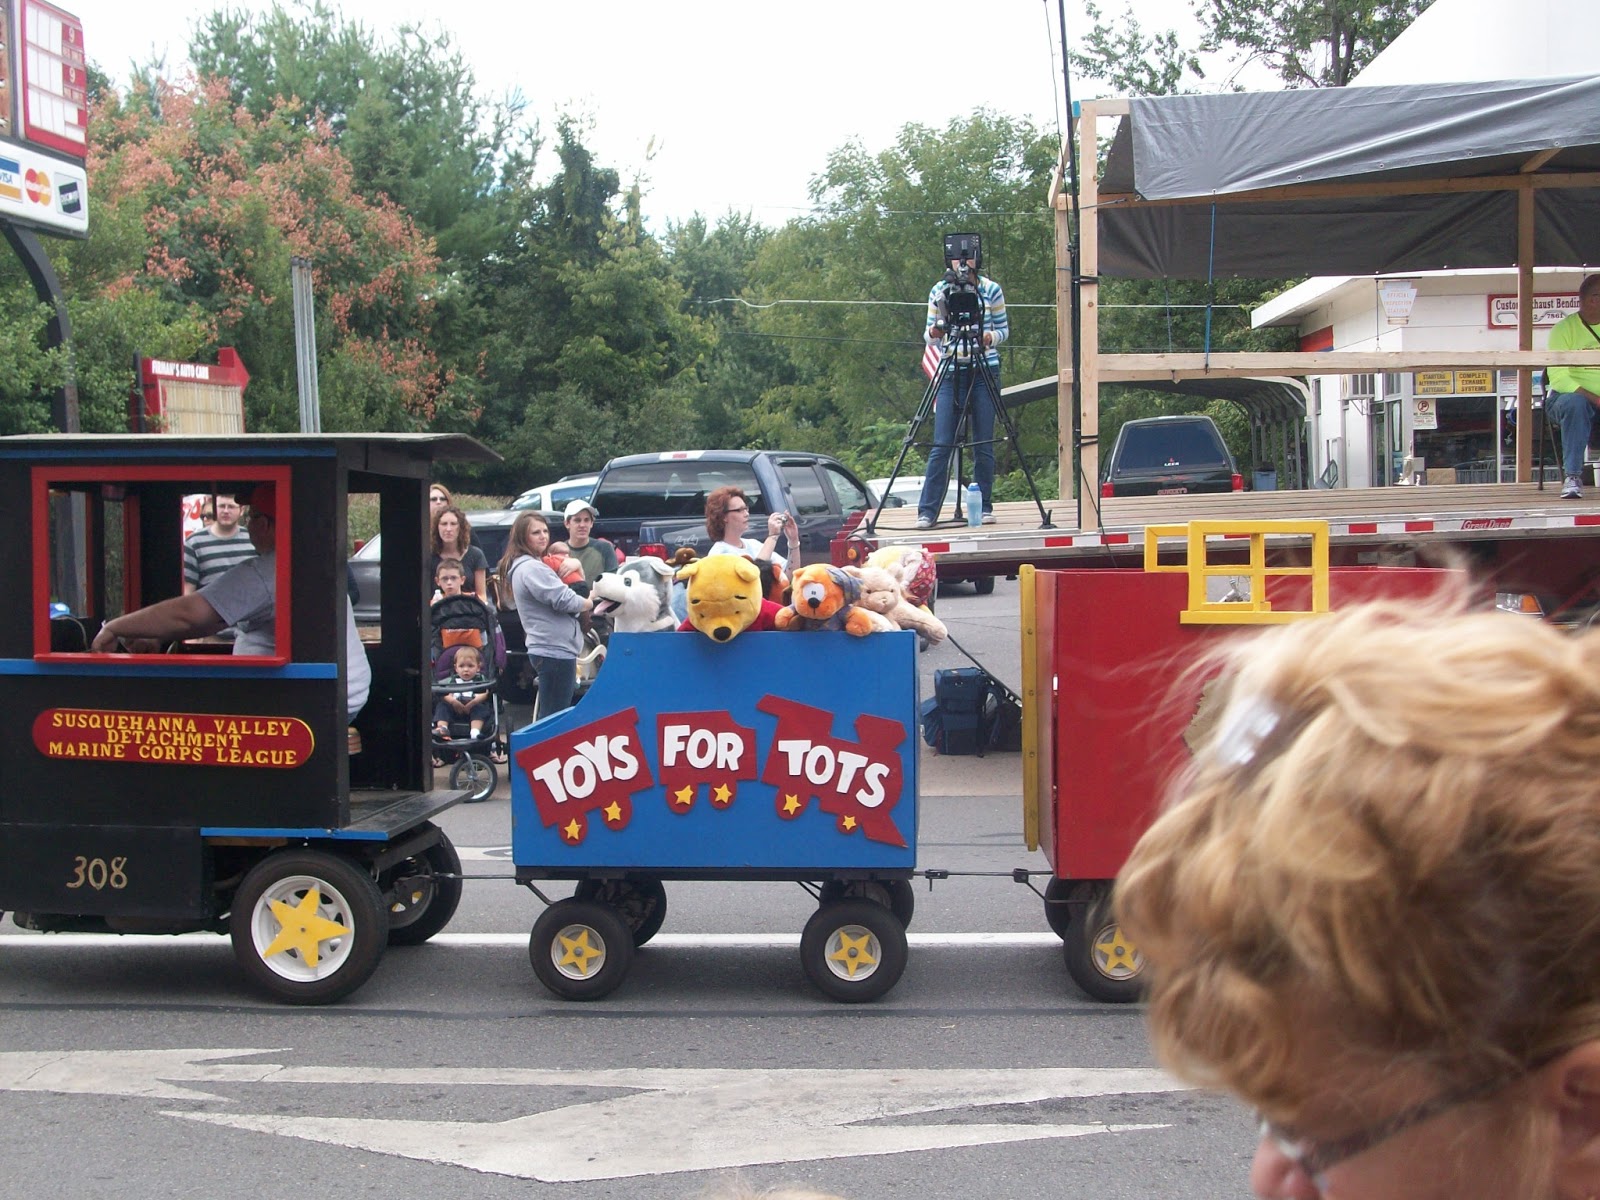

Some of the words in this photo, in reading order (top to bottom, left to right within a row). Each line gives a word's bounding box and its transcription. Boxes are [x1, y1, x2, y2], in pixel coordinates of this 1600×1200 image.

[69, 27, 75, 43] 9
[69, 67, 76, 84] 9
[1556, 298, 1580, 308] Bendin
[52, 713, 197, 733] SUSQUEHANNA
[214, 719, 292, 737] VALLEY
[107, 729, 242, 748] DETACHMENT
[49, 741, 125, 758] MARINE
[139, 745, 203, 762] CORPS
[216, 747, 297, 765] LEAGUE
[532, 735, 639, 804] TOYS
[663, 724, 744, 771] FOR
[778, 739, 890, 808] TOTS
[66, 855, 128, 890] 308
